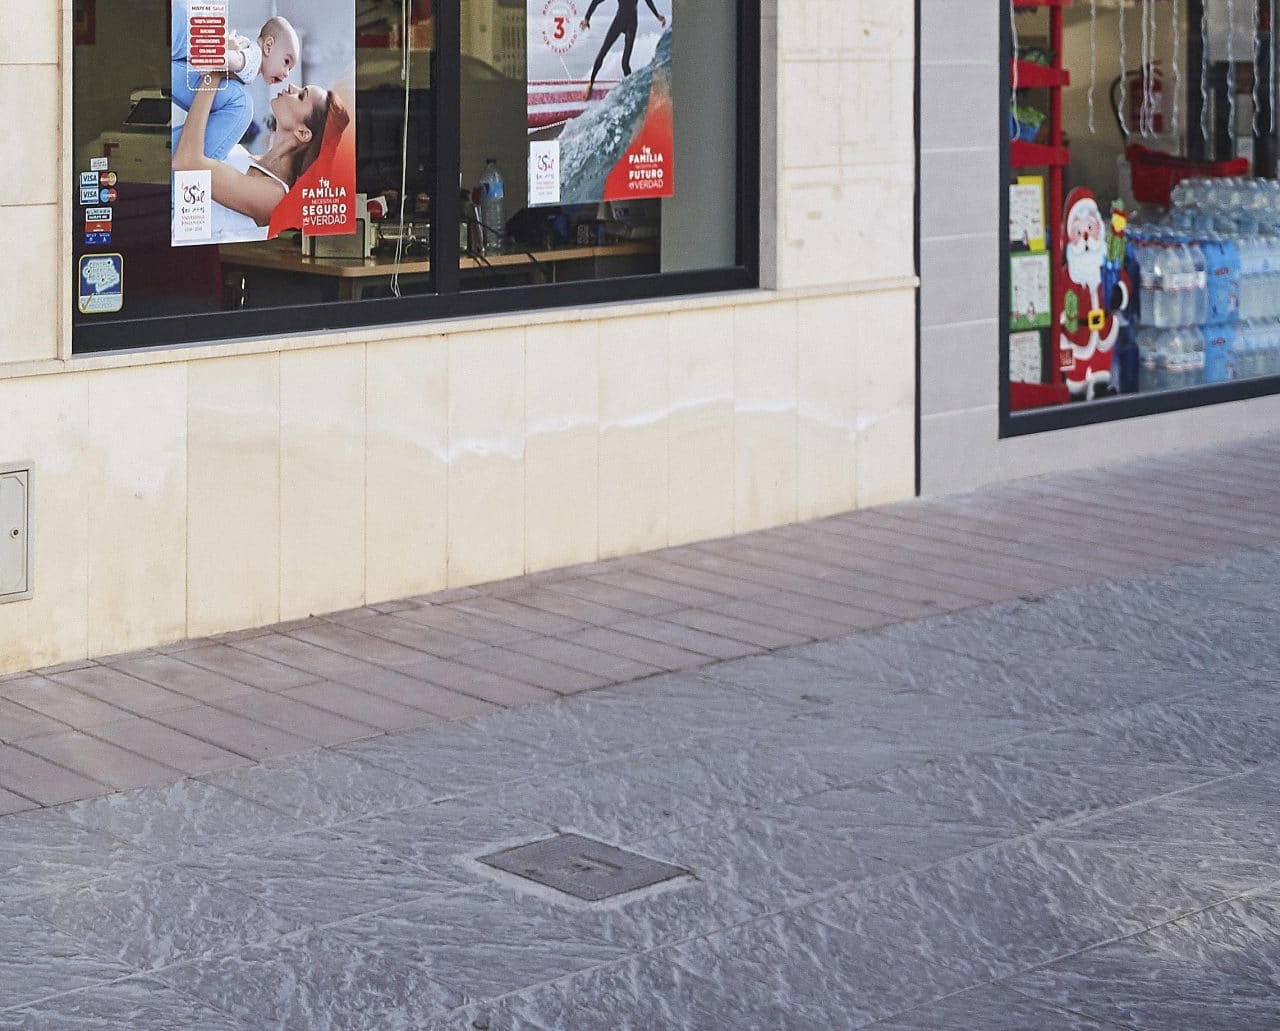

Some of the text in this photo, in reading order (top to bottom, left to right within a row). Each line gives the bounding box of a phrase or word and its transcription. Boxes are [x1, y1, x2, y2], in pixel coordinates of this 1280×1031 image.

[629, 153, 663, 164] FAMILIA
[83, 174, 97, 182] VISA
[629, 169, 664, 180] FUTURO
[302, 186, 347, 199] FAMILIA
[302, 203, 347, 216] SEGURO
[310, 214, 347, 226] VERDAD
